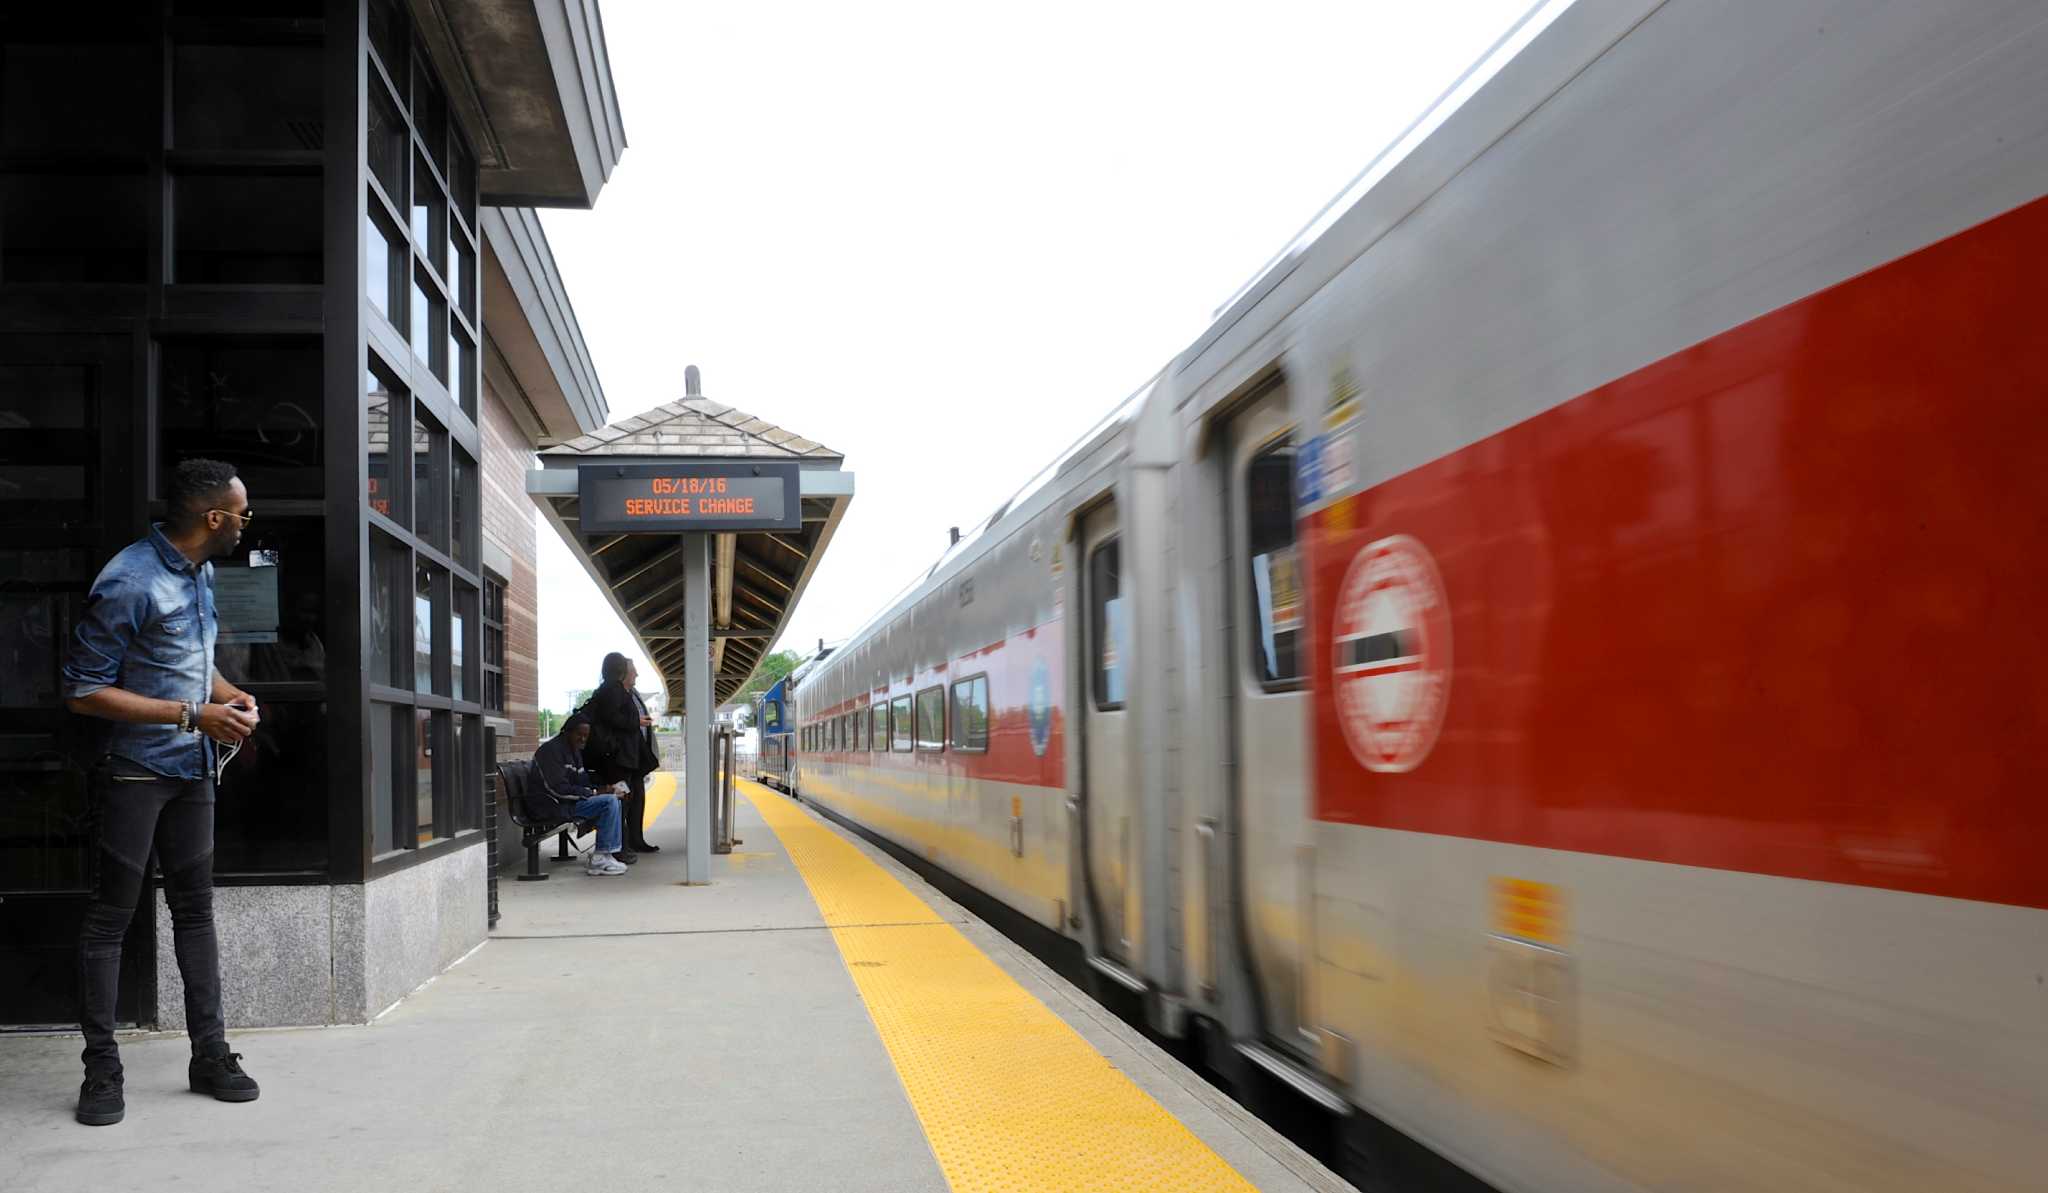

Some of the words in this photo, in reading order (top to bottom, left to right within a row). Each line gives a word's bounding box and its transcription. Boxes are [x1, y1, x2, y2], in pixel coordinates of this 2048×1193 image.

[652, 478, 727, 494] 05/18/16
[626, 498, 690, 515] SERVICE
[699, 498, 754, 514] CHANGE
